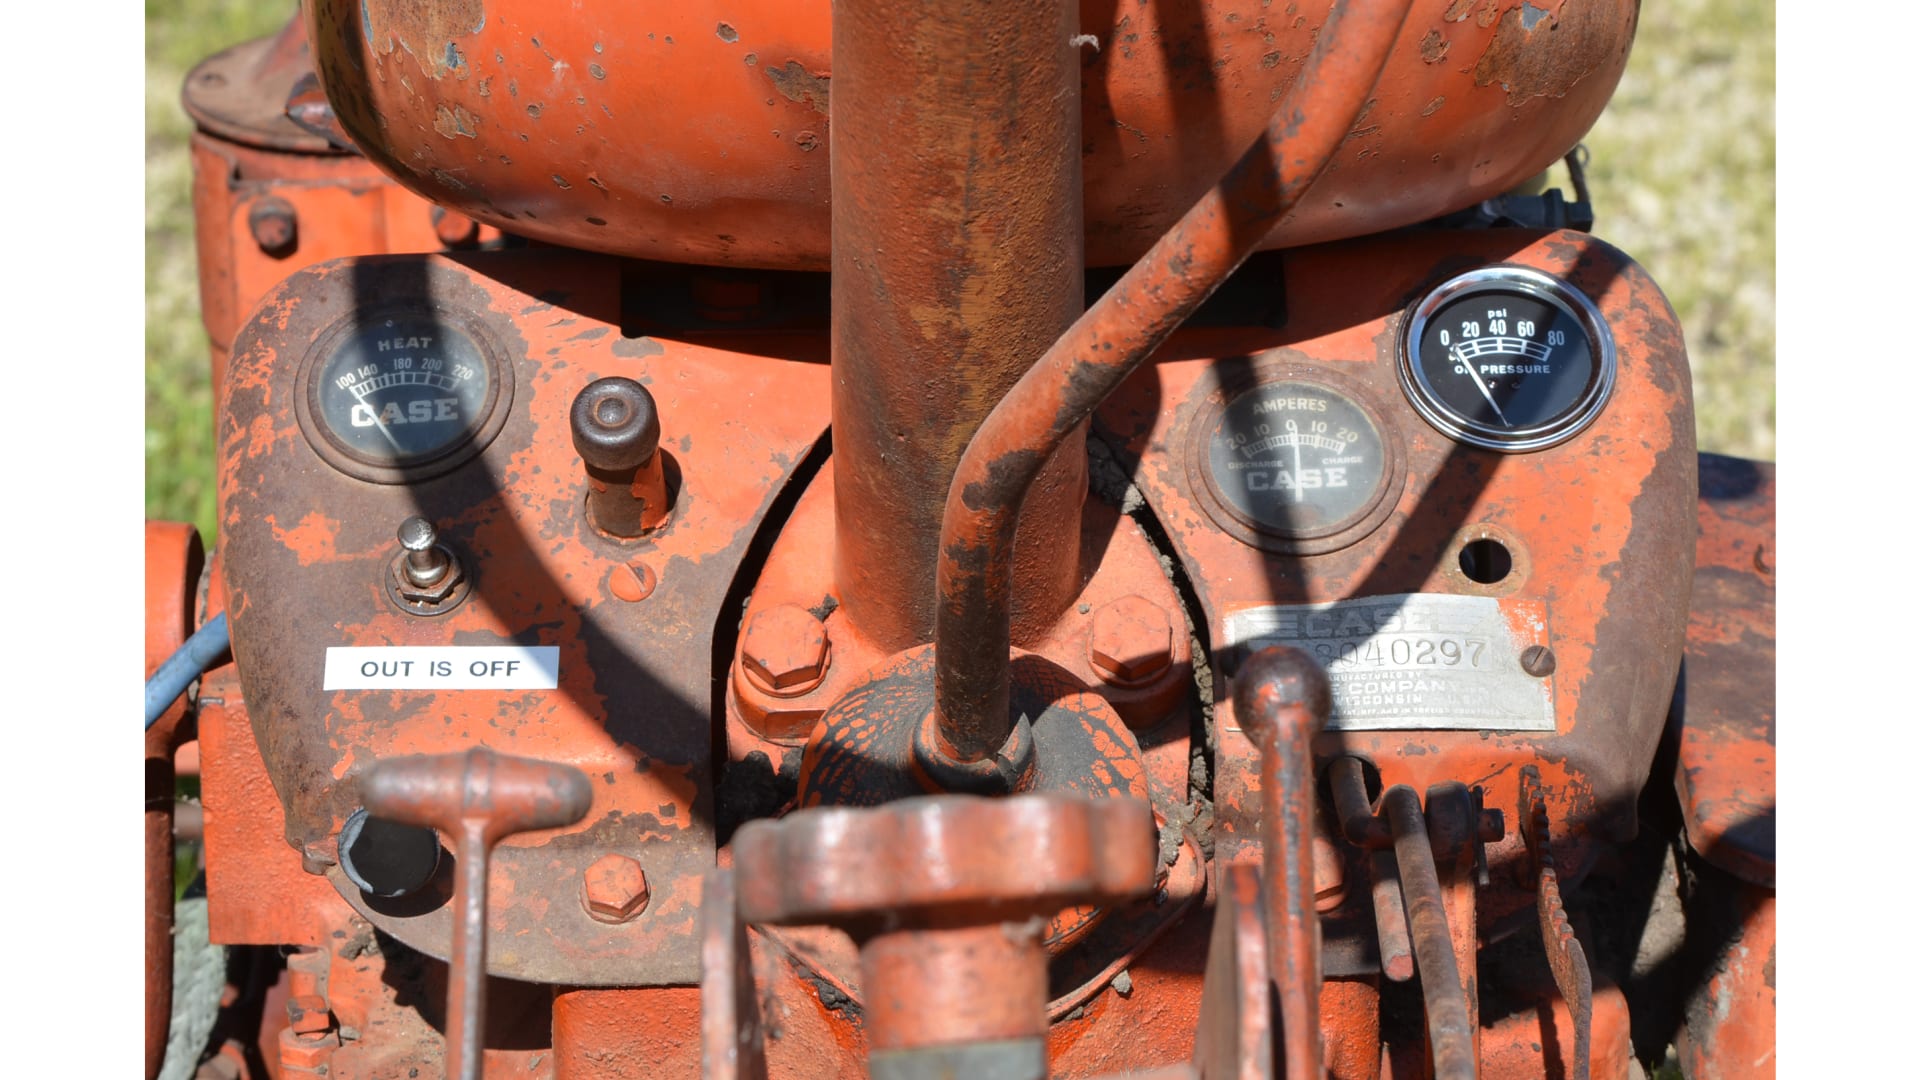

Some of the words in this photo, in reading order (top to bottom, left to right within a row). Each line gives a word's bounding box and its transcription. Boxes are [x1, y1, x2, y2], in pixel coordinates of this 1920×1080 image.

[1488, 308, 1507, 319] psi
[377, 336, 433, 351] HEAT
[1440, 330, 1450, 346] 0
[1462, 321, 1480, 337] 20
[1489, 319, 1507, 335] 40
[1517, 321, 1535, 337] 60
[1548, 330, 1565, 346] 80
[335, 372, 356, 390] 100
[357, 363, 378, 379] 140
[394, 357, 412, 370] 180
[421, 358, 442, 371] 200
[451, 364, 474, 380] 220
[1480, 364, 1551, 374] PRESSURE
[351, 398, 458, 427] CASE
[1253, 397, 1327, 414] AMPERES
[1227, 432, 1247, 450] 20
[1254, 423, 1270, 437] 10
[1285, 419, 1297, 432] 0
[1311, 420, 1328, 433] 10
[1336, 427, 1358, 443] 20
[1247, 467, 1349, 491] CASE
[1305, 606, 1433, 637] CASE
[361, 660, 414, 677] OUT
[430, 660, 452, 677] IS
[469, 660, 521, 677] OFF
